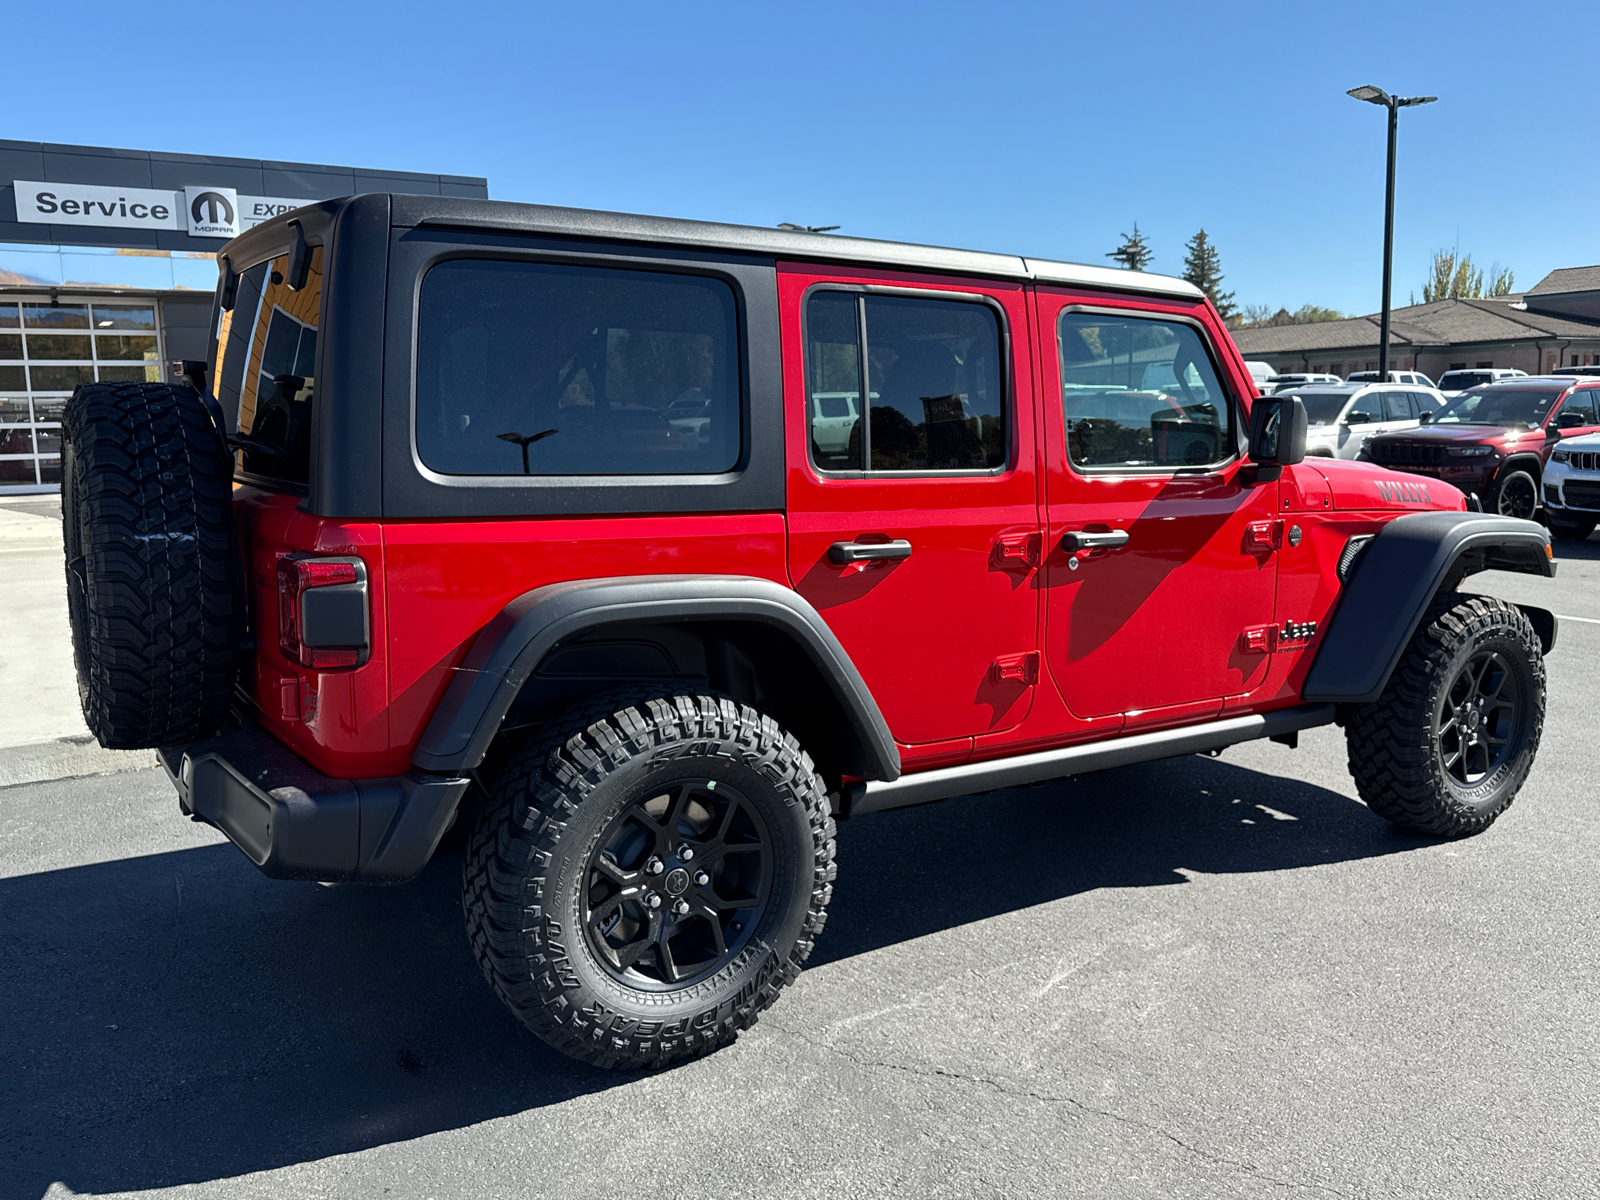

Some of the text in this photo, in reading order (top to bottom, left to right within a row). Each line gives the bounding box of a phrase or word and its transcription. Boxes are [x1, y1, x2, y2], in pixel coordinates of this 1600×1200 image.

[36, 191, 170, 220] Service
[1374, 480, 1431, 503] WILLYS
[1280, 619, 1317, 641] Jeep
[645, 739, 799, 808] FALKEN
[582, 948, 780, 1038] WILDPEAK
